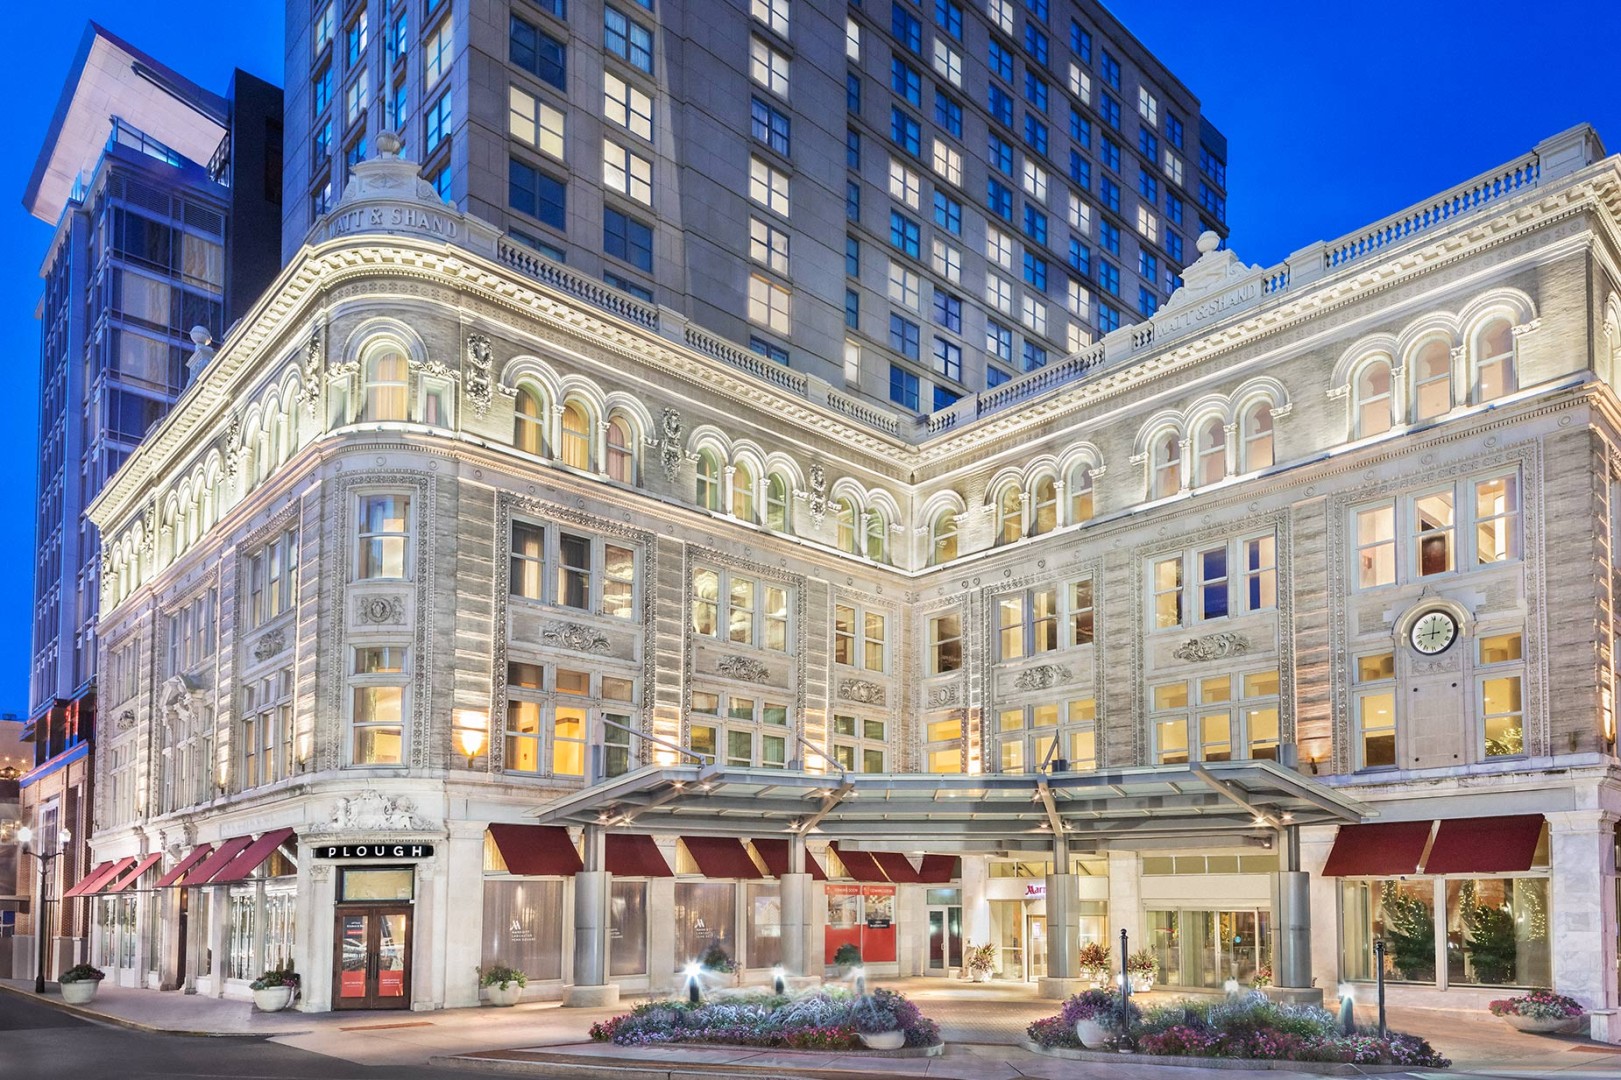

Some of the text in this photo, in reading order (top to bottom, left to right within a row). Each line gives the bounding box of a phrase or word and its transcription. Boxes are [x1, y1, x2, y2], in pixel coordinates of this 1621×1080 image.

[370, 207, 383, 225] &
[391, 207, 458, 239] SHAND
[1155, 309, 1195, 338] WATT
[1208, 283, 1257, 316] SHAND
[328, 845, 422, 858] PLOUGH
[1024, 885, 1046, 896] Marr
